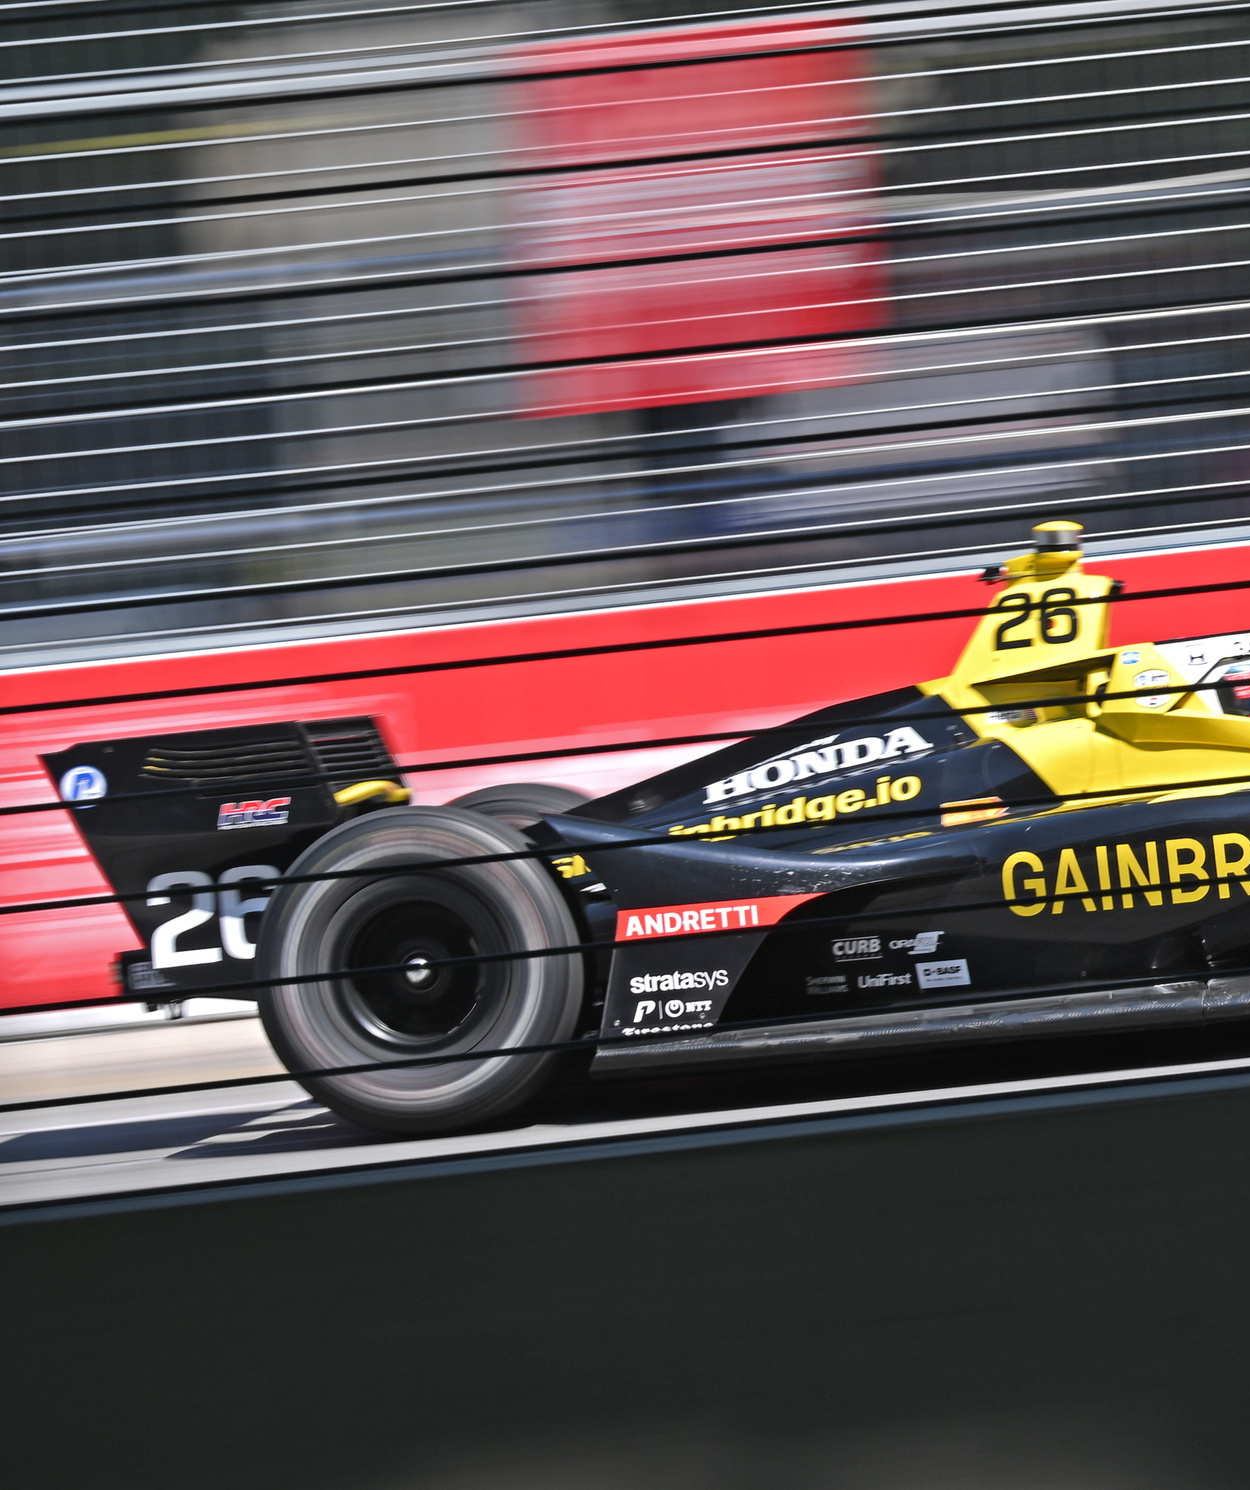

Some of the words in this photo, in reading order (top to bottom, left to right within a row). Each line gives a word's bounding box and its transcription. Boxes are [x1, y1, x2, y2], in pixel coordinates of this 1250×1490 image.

[996, 587, 1079, 651] 26
[702, 725, 934, 805] HONDA
[146, 865, 284, 970] 26
[625, 905, 759, 937] ANDRETTI
[832, 938, 882, 957] CURB
[630, 969, 729, 994] stratasys
[857, 972, 912, 988] UniFirst
